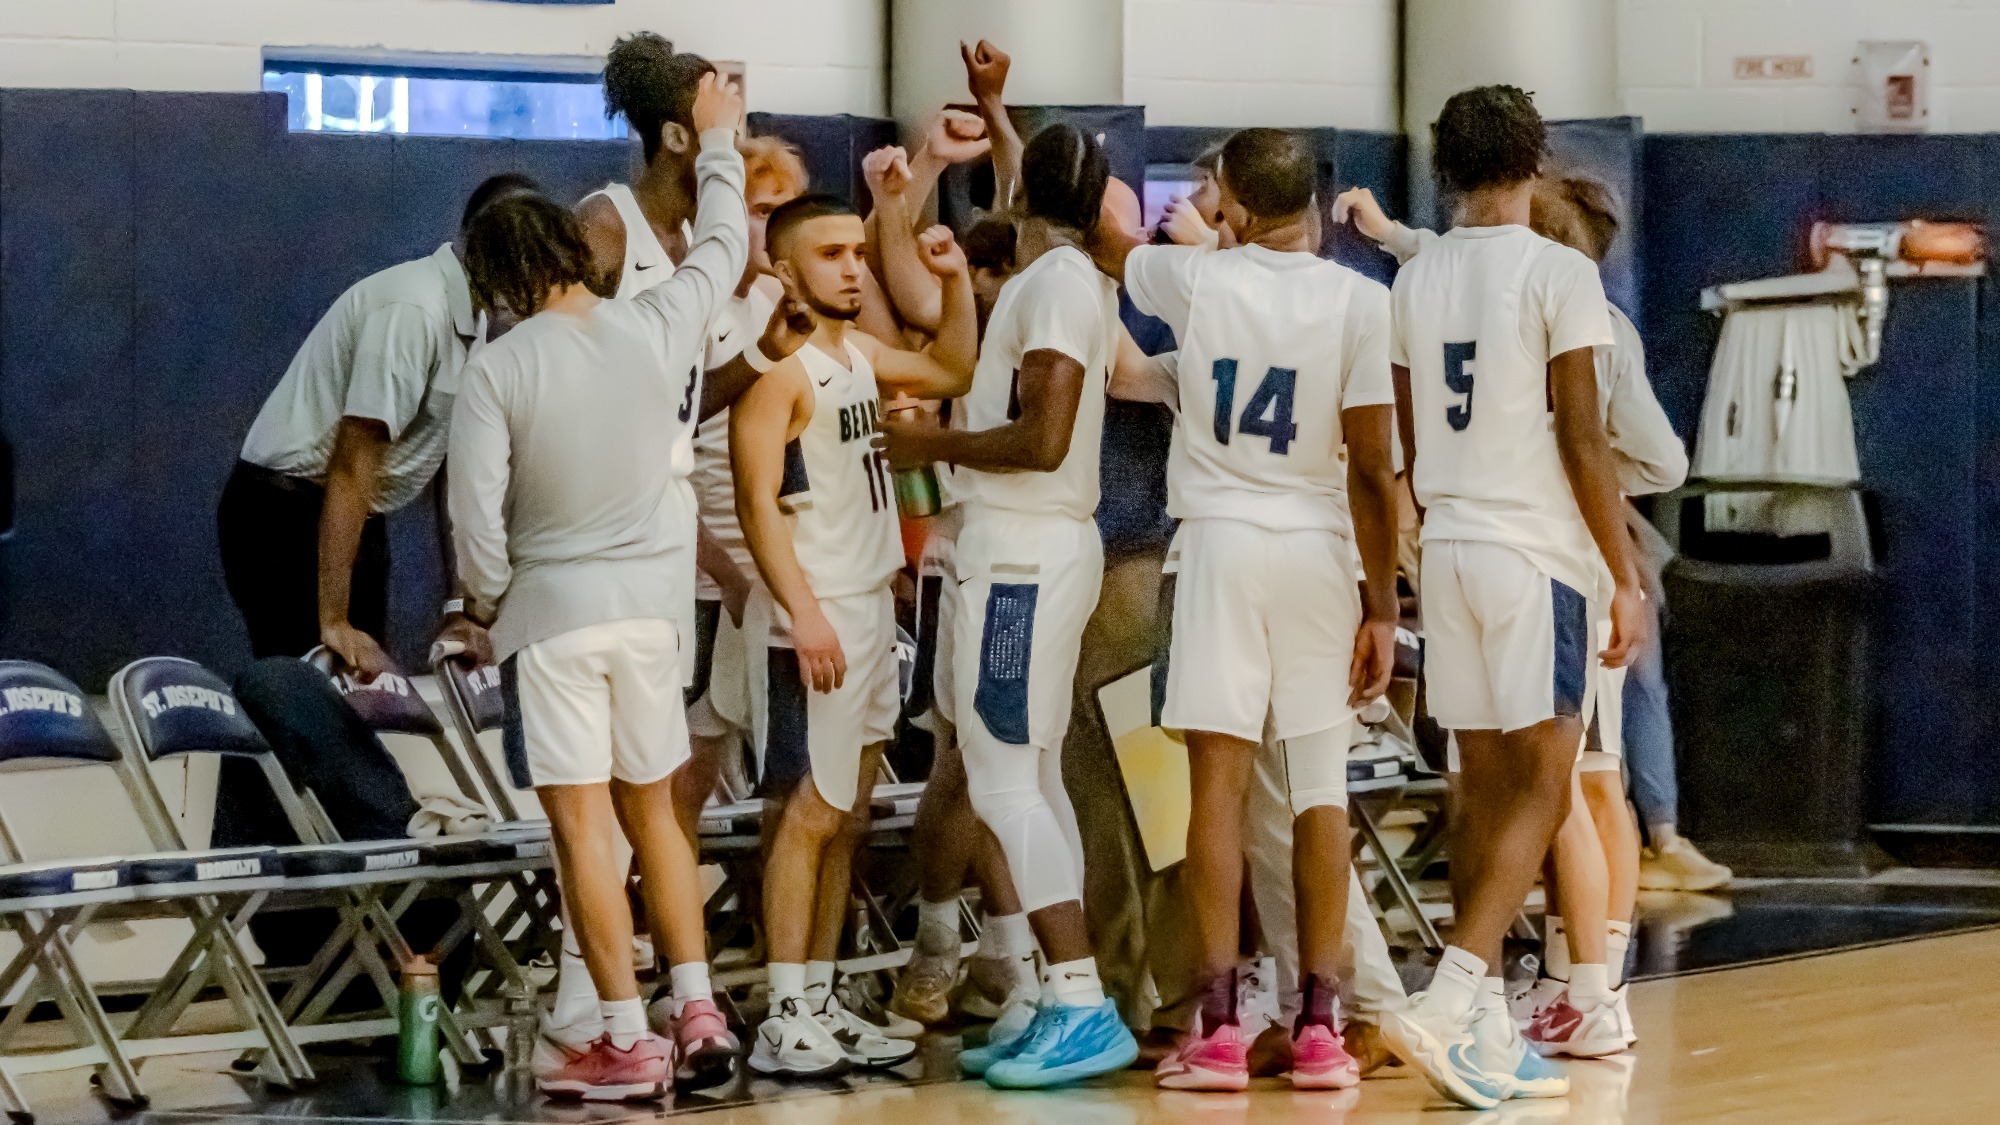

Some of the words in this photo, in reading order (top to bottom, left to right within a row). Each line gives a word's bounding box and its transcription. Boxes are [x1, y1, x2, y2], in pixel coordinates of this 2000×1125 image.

[838, 397, 881, 443] BEAR
[1211, 357, 1297, 456] 14
[1443, 339, 1477, 432] 5
[861, 451, 889, 514] 11
